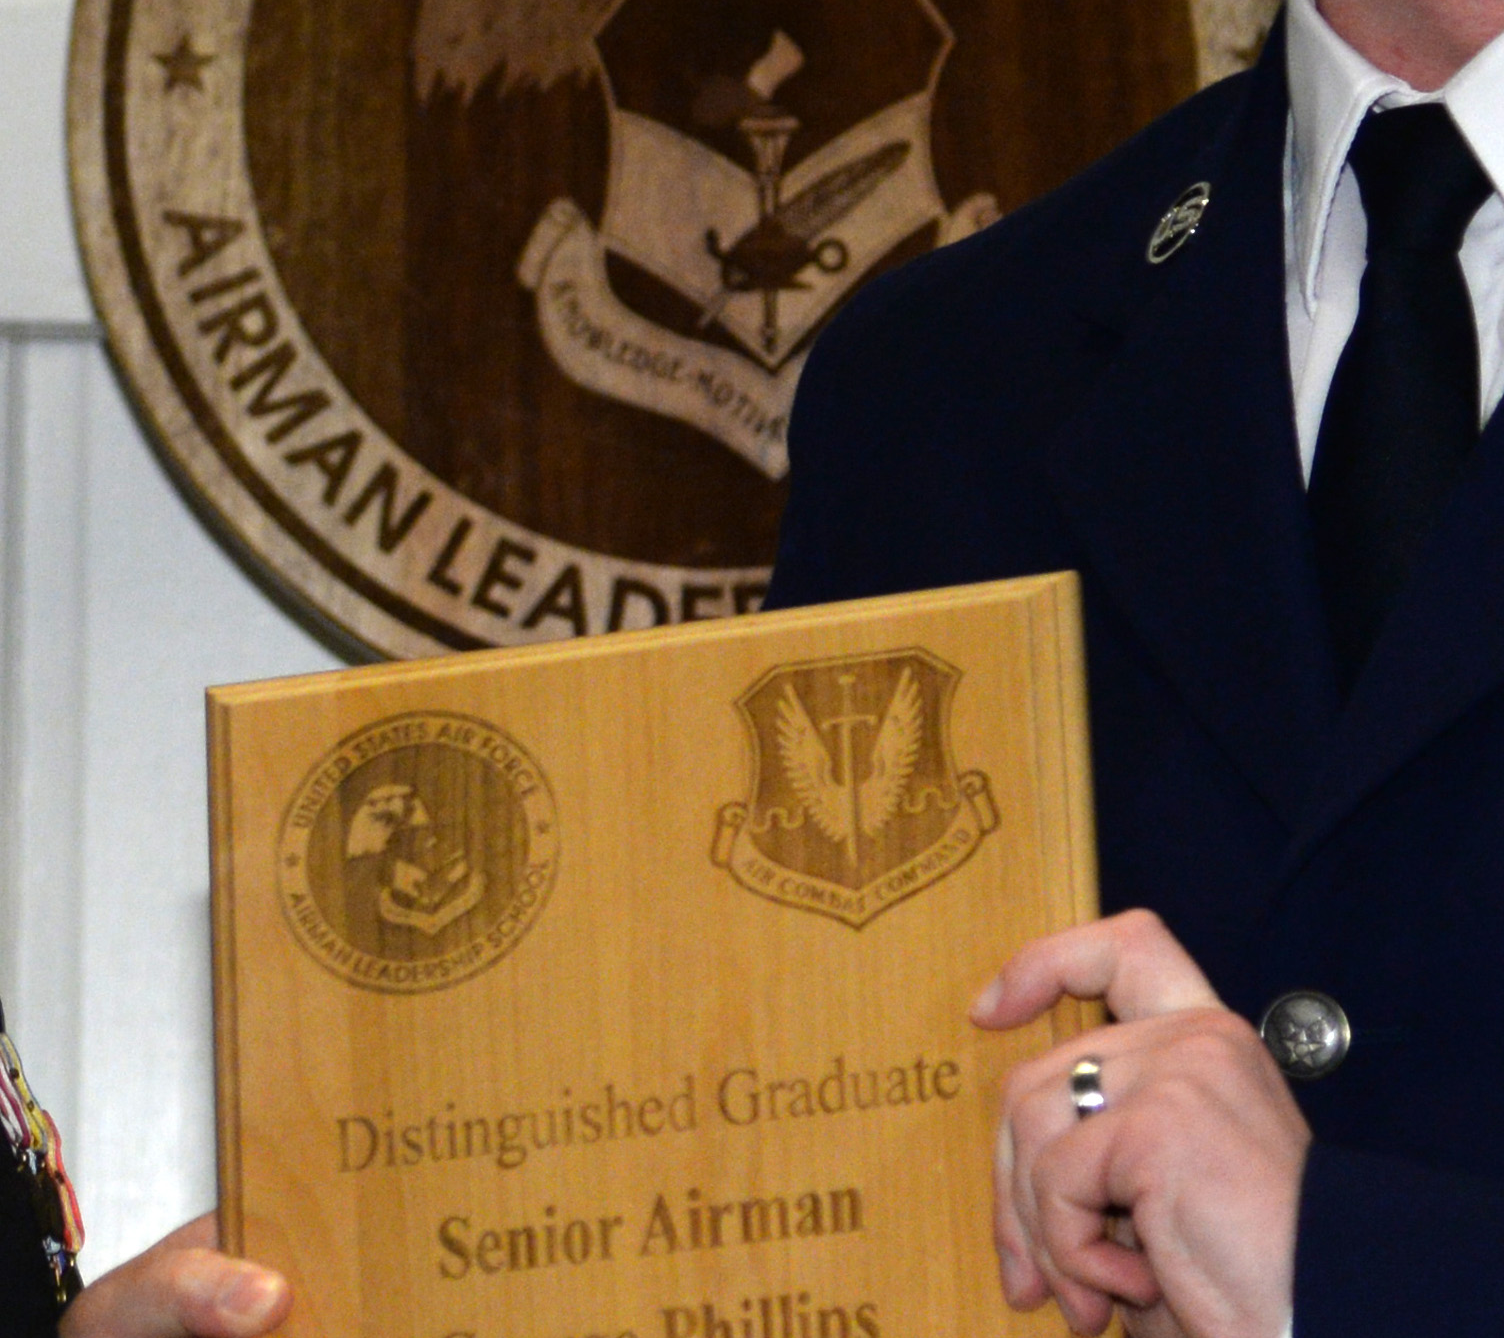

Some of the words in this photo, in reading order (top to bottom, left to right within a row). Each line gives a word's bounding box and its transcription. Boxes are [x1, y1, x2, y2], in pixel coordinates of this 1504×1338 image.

[162, 208, 433, 554] AIRMAN
[335, 1075, 698, 1173] Distinguished
[717, 1054, 962, 1127] Graduate
[437, 1204, 625, 1280] Senior
[639, 1186, 865, 1258] Airman
